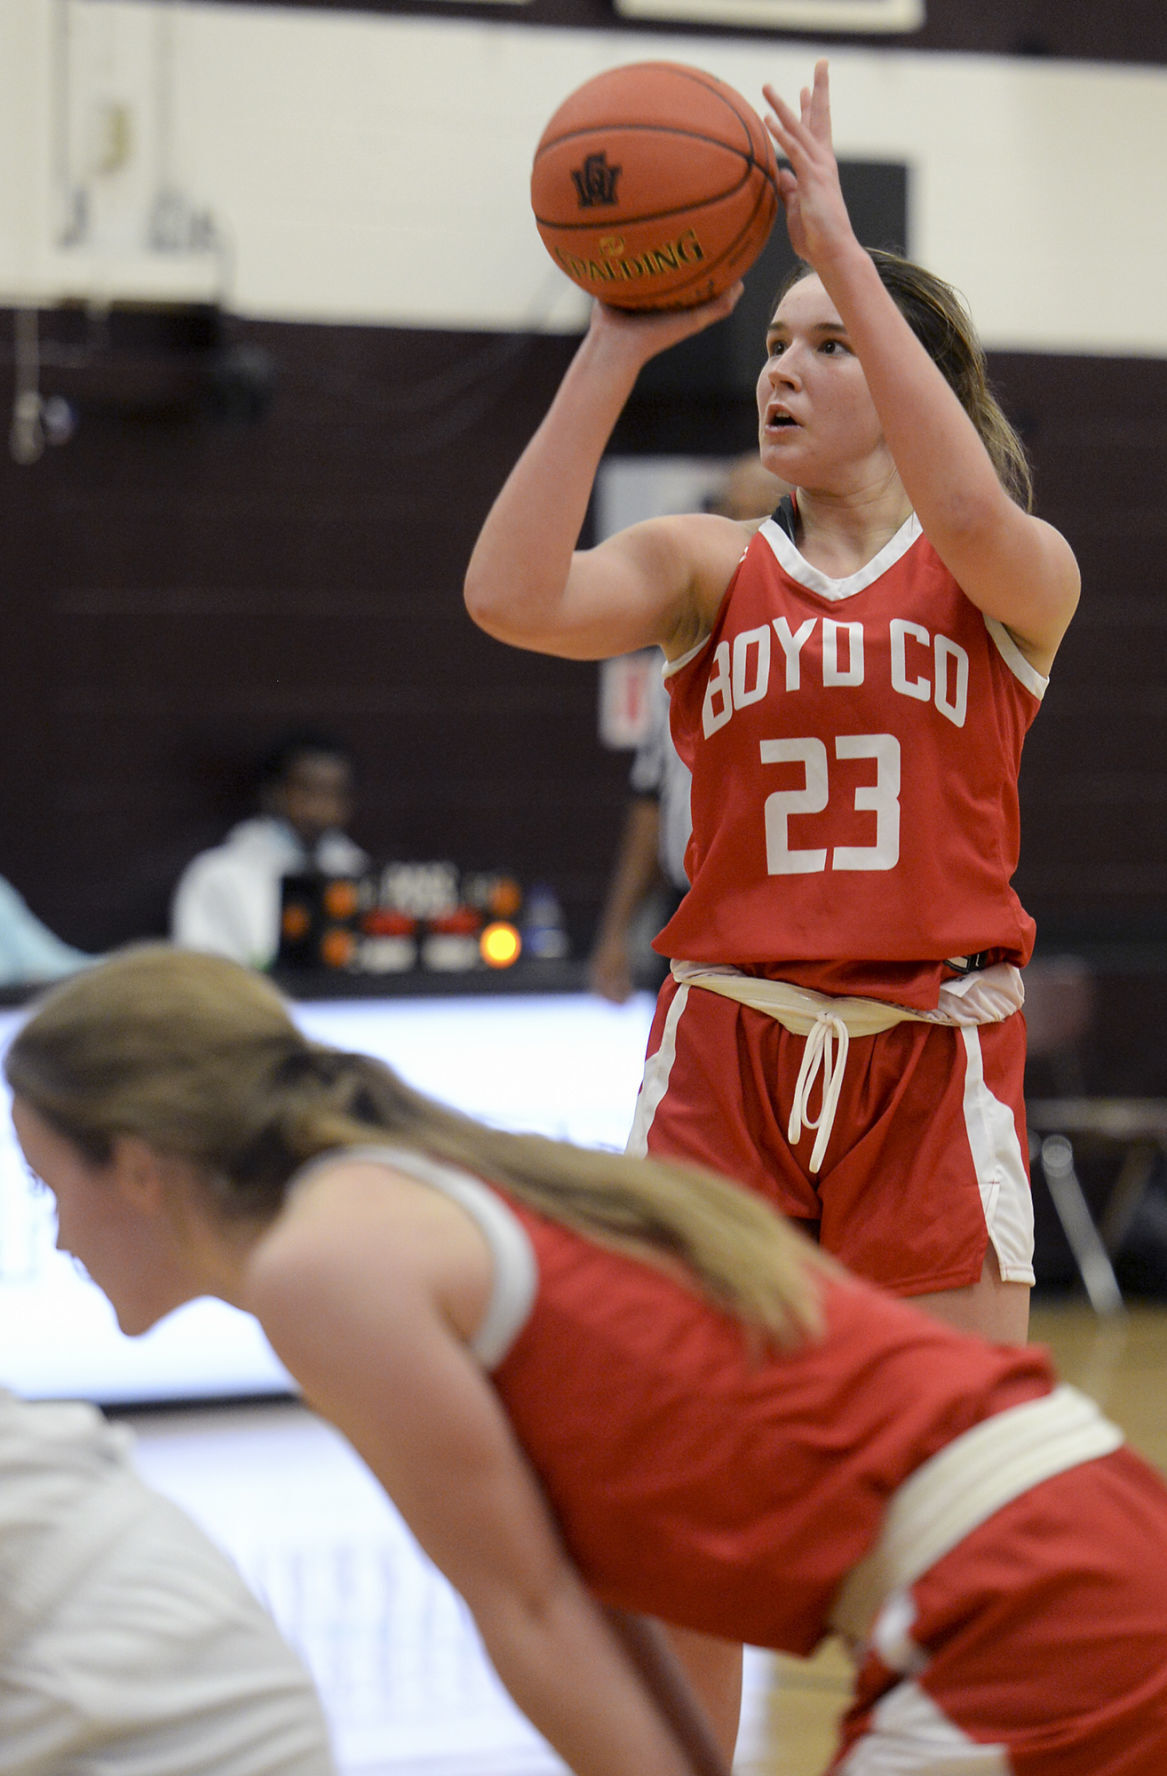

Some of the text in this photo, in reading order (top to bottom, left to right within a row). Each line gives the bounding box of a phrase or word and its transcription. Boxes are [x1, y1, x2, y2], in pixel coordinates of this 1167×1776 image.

[554, 228, 704, 281] SPALDING
[702, 616, 969, 740] BOYD CO
[760, 733, 900, 875] 23
